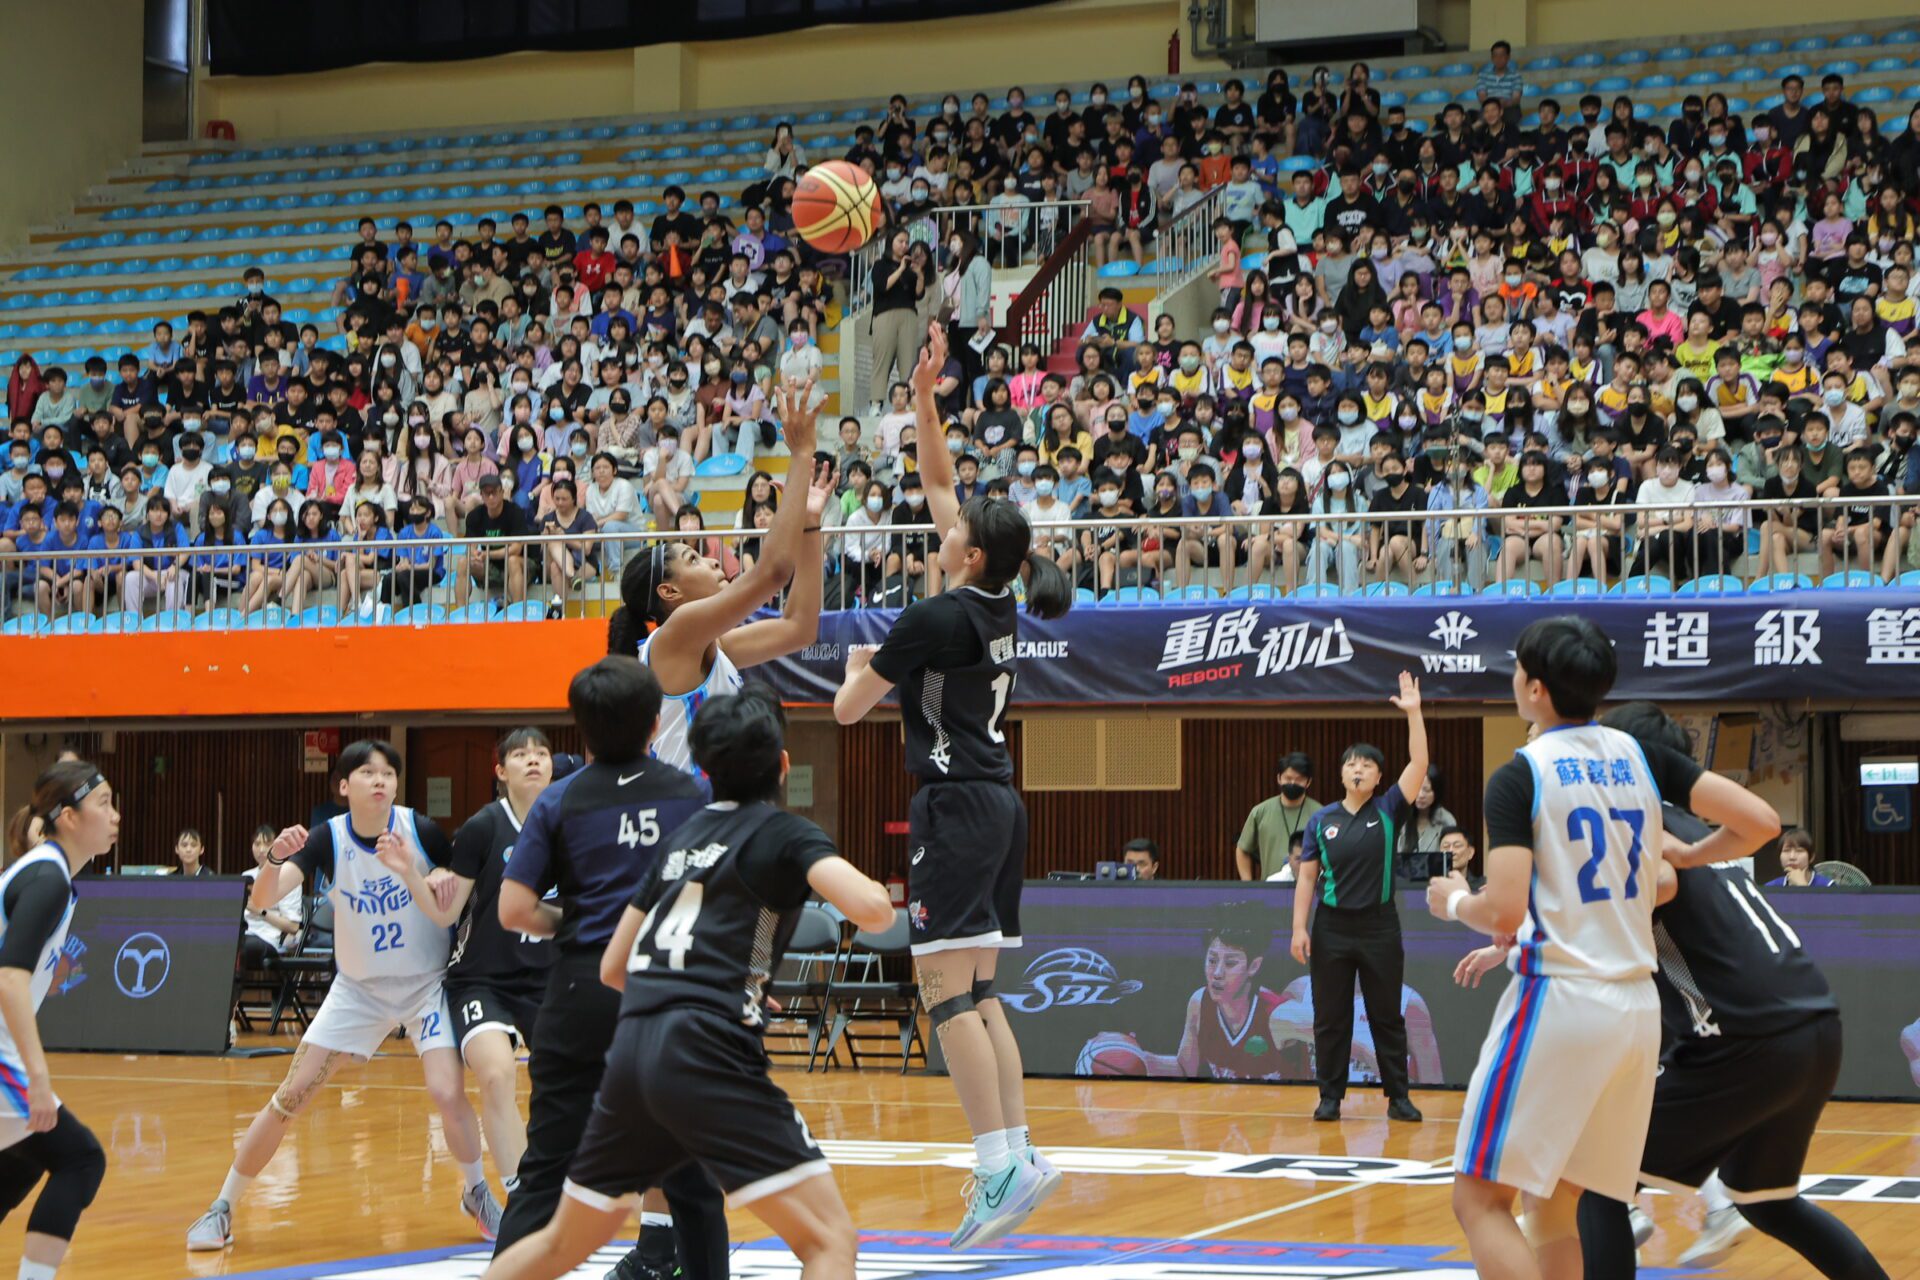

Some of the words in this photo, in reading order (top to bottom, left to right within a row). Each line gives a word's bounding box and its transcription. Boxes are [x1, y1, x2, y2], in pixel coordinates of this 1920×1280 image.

[1015, 640, 1069, 659] EAGUE
[1156, 606, 1355, 678] 重啟初心
[1168, 663, 1243, 689] REBOOT
[1420, 654, 1487, 674] WSBL
[617, 808, 661, 850] 45
[1567, 806, 1645, 904] 27
[1726, 878, 1802, 955] 11
[371, 922, 405, 953] 22
[420, 1011, 441, 1041] 22
[462, 999, 484, 1026] 13
